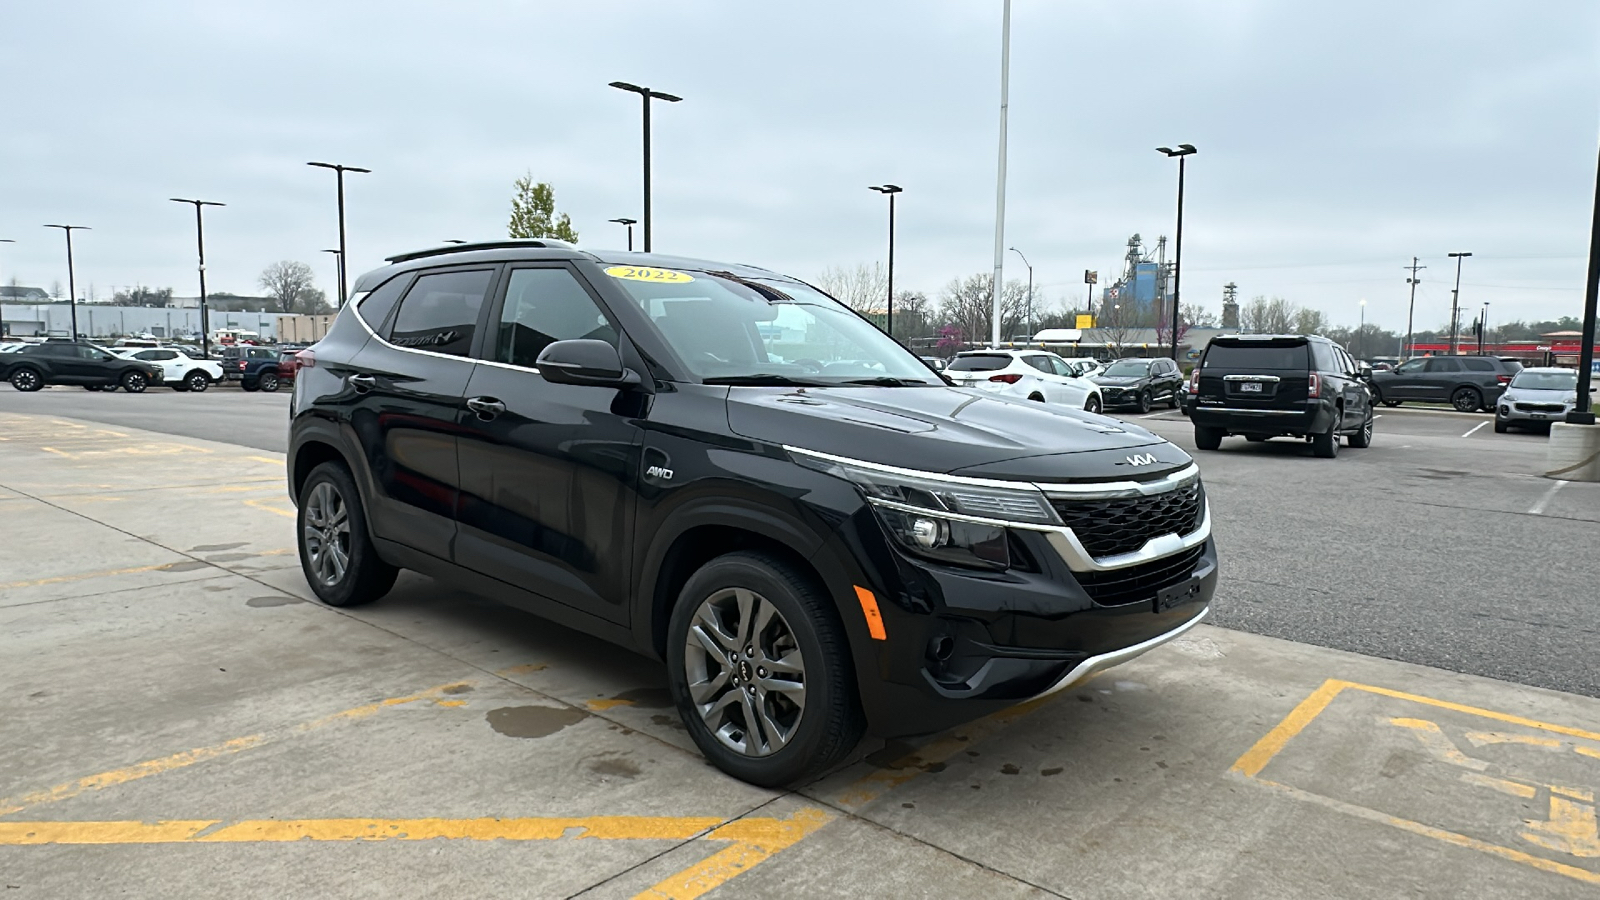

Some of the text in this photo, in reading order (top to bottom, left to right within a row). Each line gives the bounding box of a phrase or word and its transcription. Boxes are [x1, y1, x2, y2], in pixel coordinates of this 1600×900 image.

[623, 268, 678, 280] 2022
[1126, 452, 1157, 466] KIA
[646, 465, 673, 479] AWD
